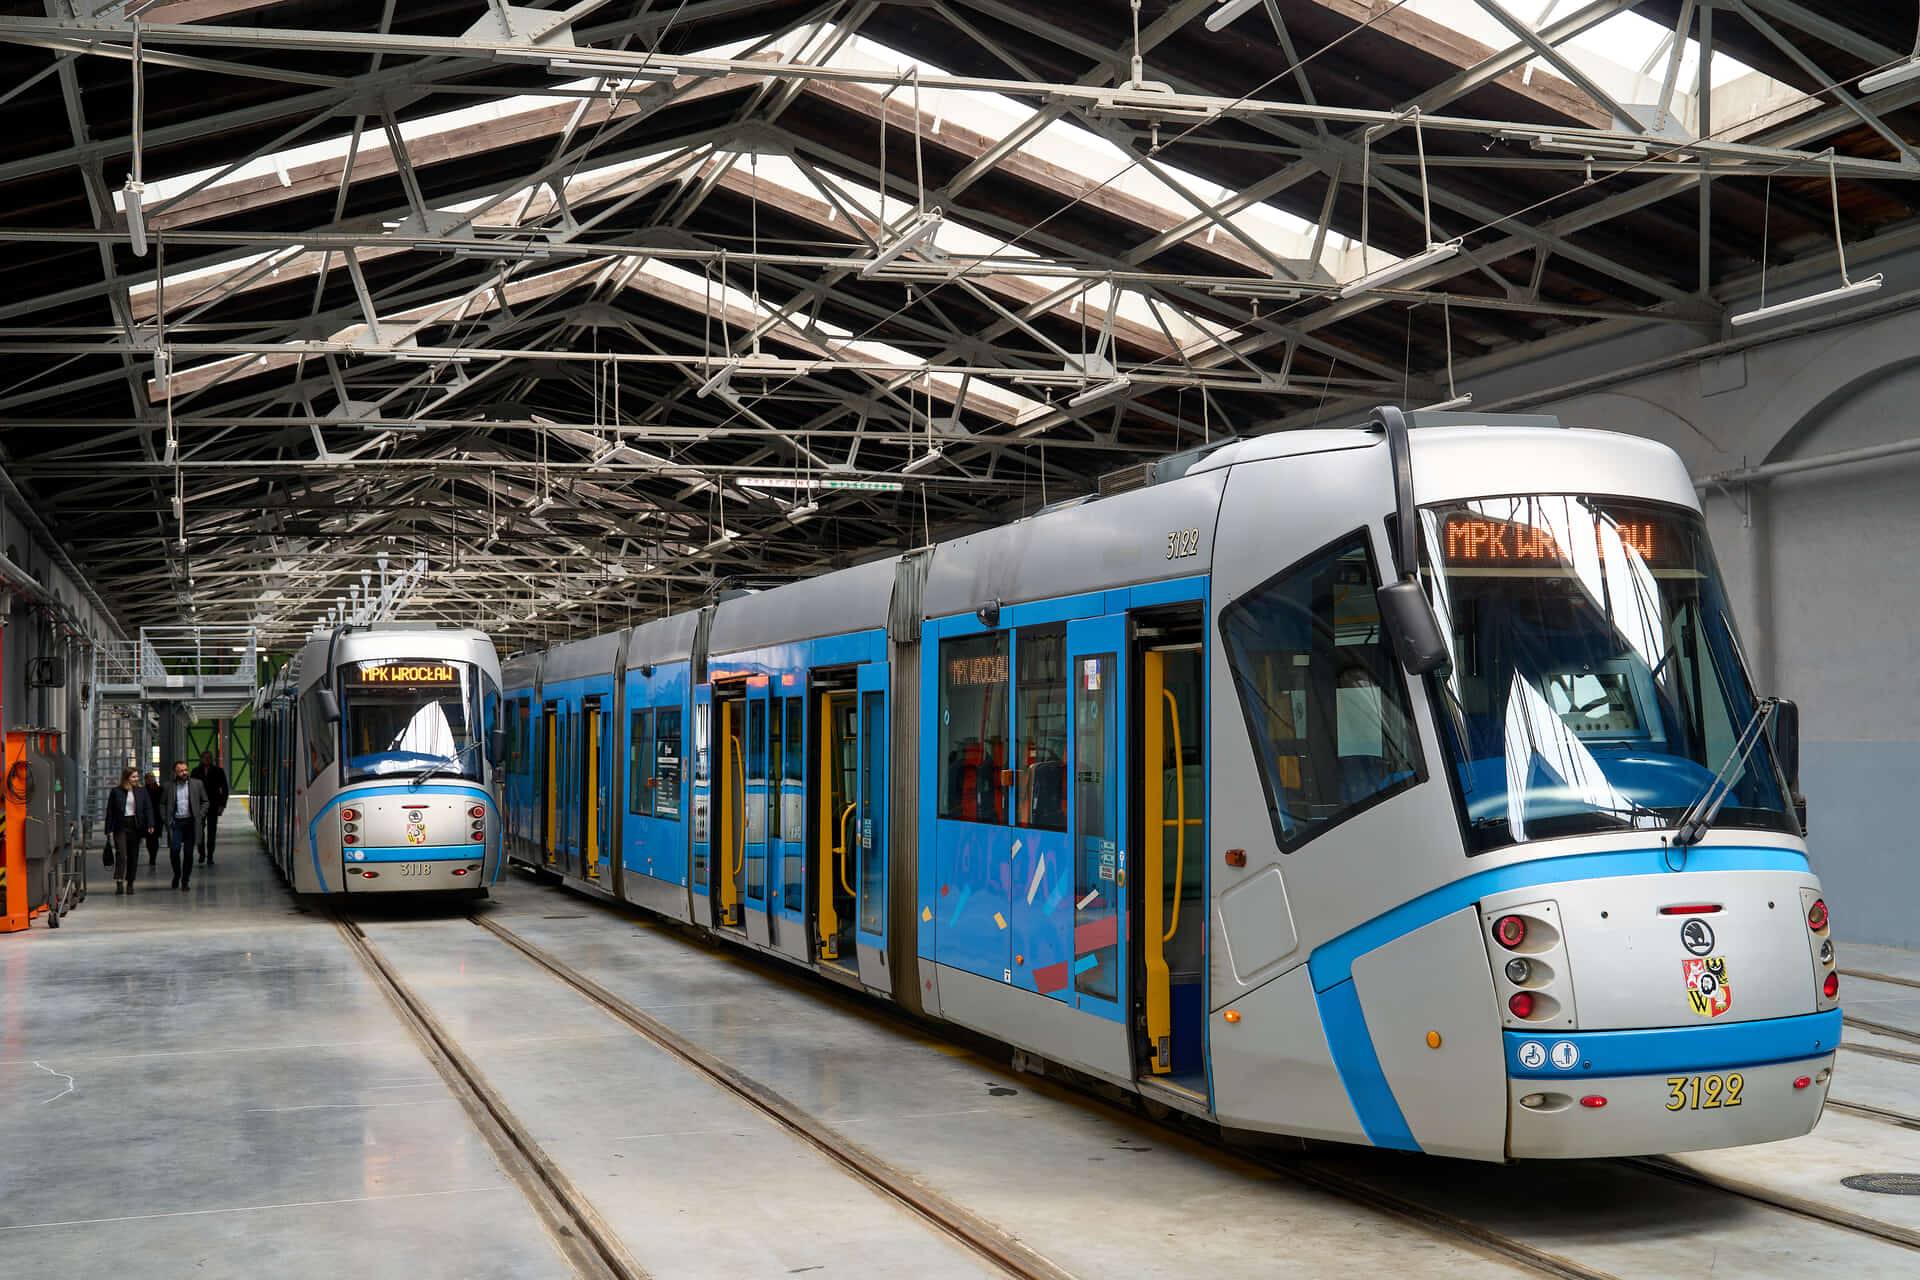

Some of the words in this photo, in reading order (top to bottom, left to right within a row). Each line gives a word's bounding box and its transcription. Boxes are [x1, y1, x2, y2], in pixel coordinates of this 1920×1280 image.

[1166, 528, 1200, 560] 3122
[1449, 521, 1509, 558] MPK
[362, 667, 389, 682] MPK
[391, 667, 453, 681] WROCŁAW
[400, 863, 432, 877] 3118
[1665, 1073, 1745, 1112] 3122
